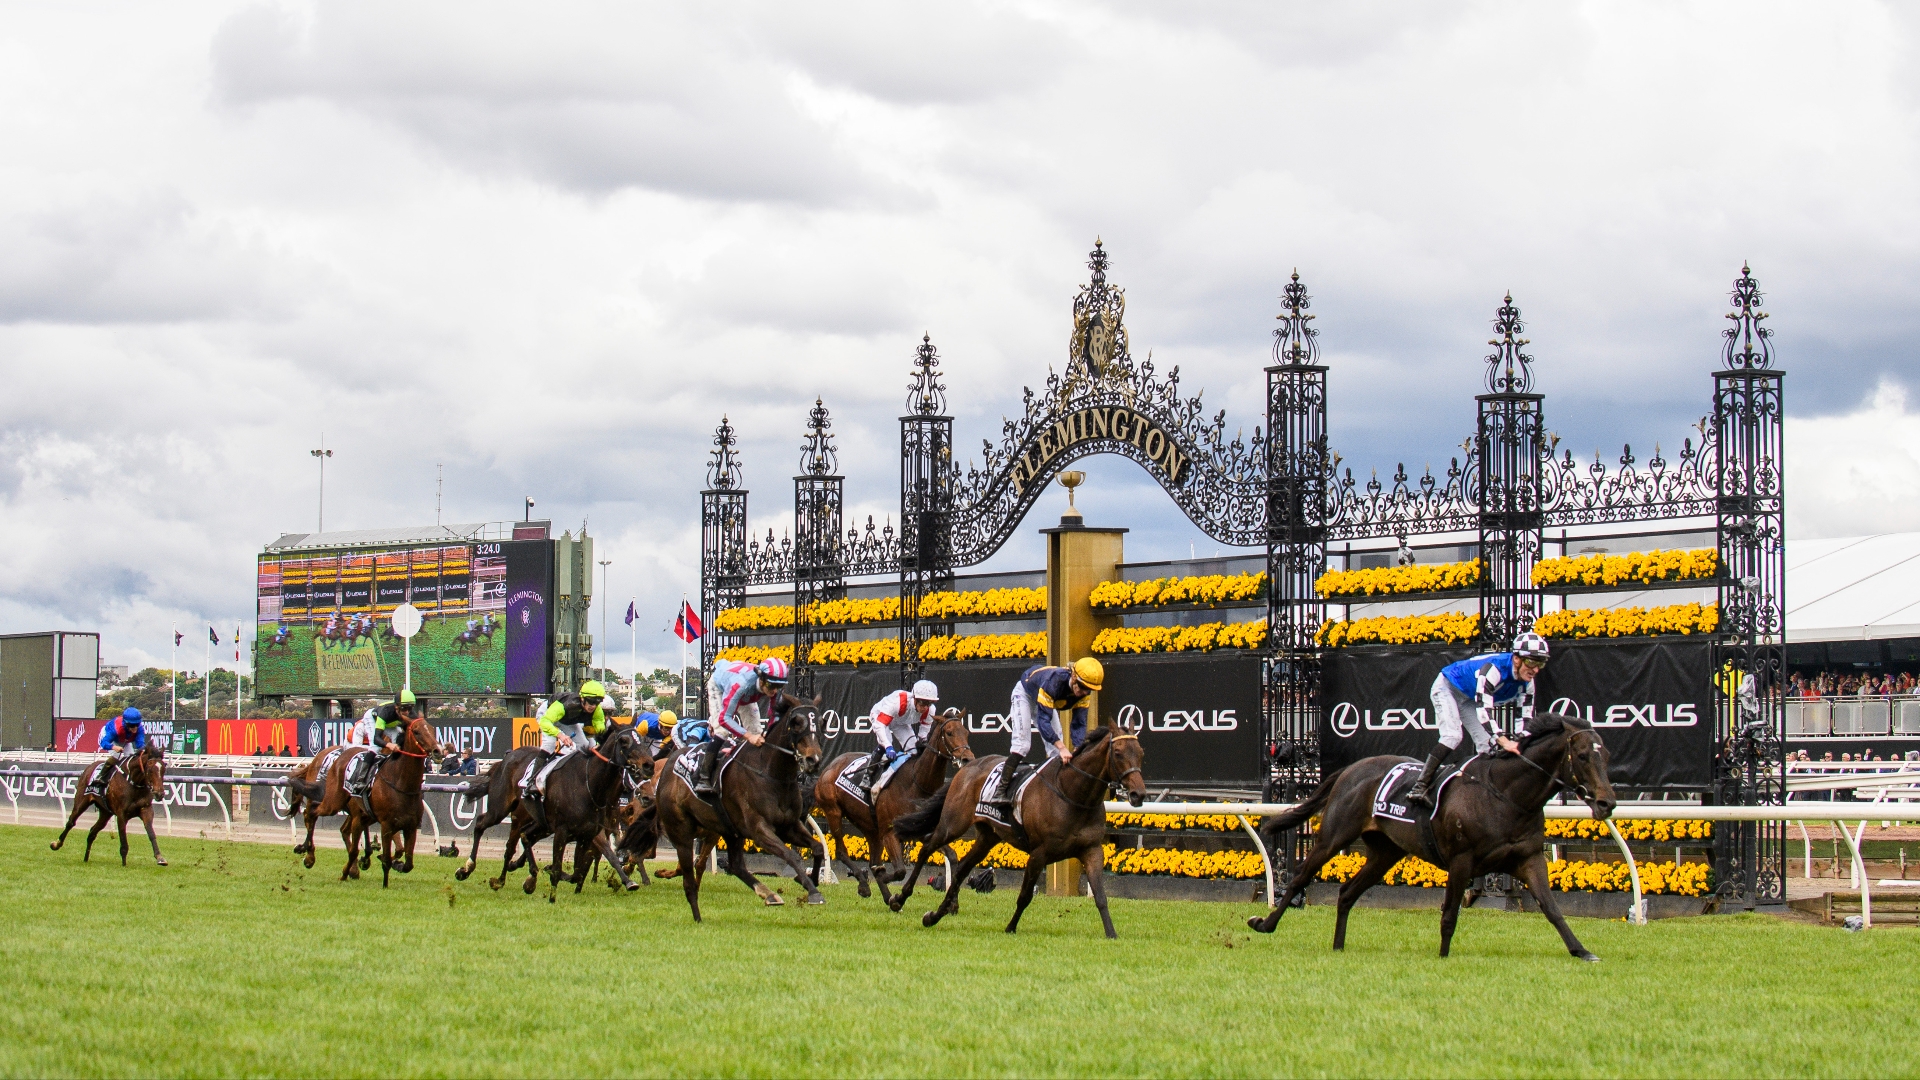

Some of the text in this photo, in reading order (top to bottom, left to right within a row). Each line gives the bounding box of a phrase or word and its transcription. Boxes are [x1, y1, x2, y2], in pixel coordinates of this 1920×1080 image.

[1010, 407, 1187, 497] FLEMINGTON
[477, 543, 500, 555] 3:24.0
[328, 654, 374, 670] FLEMINGTON
[1148, 710, 1238, 732] LEXUS
[1586, 704, 1698, 728] LEXUS
[24, 776, 79, 798] LEXUS
[151, 782, 211, 806] EXUS
[1378, 769, 1404, 802] 1
[1390, 803, 1406, 816] TRIP
